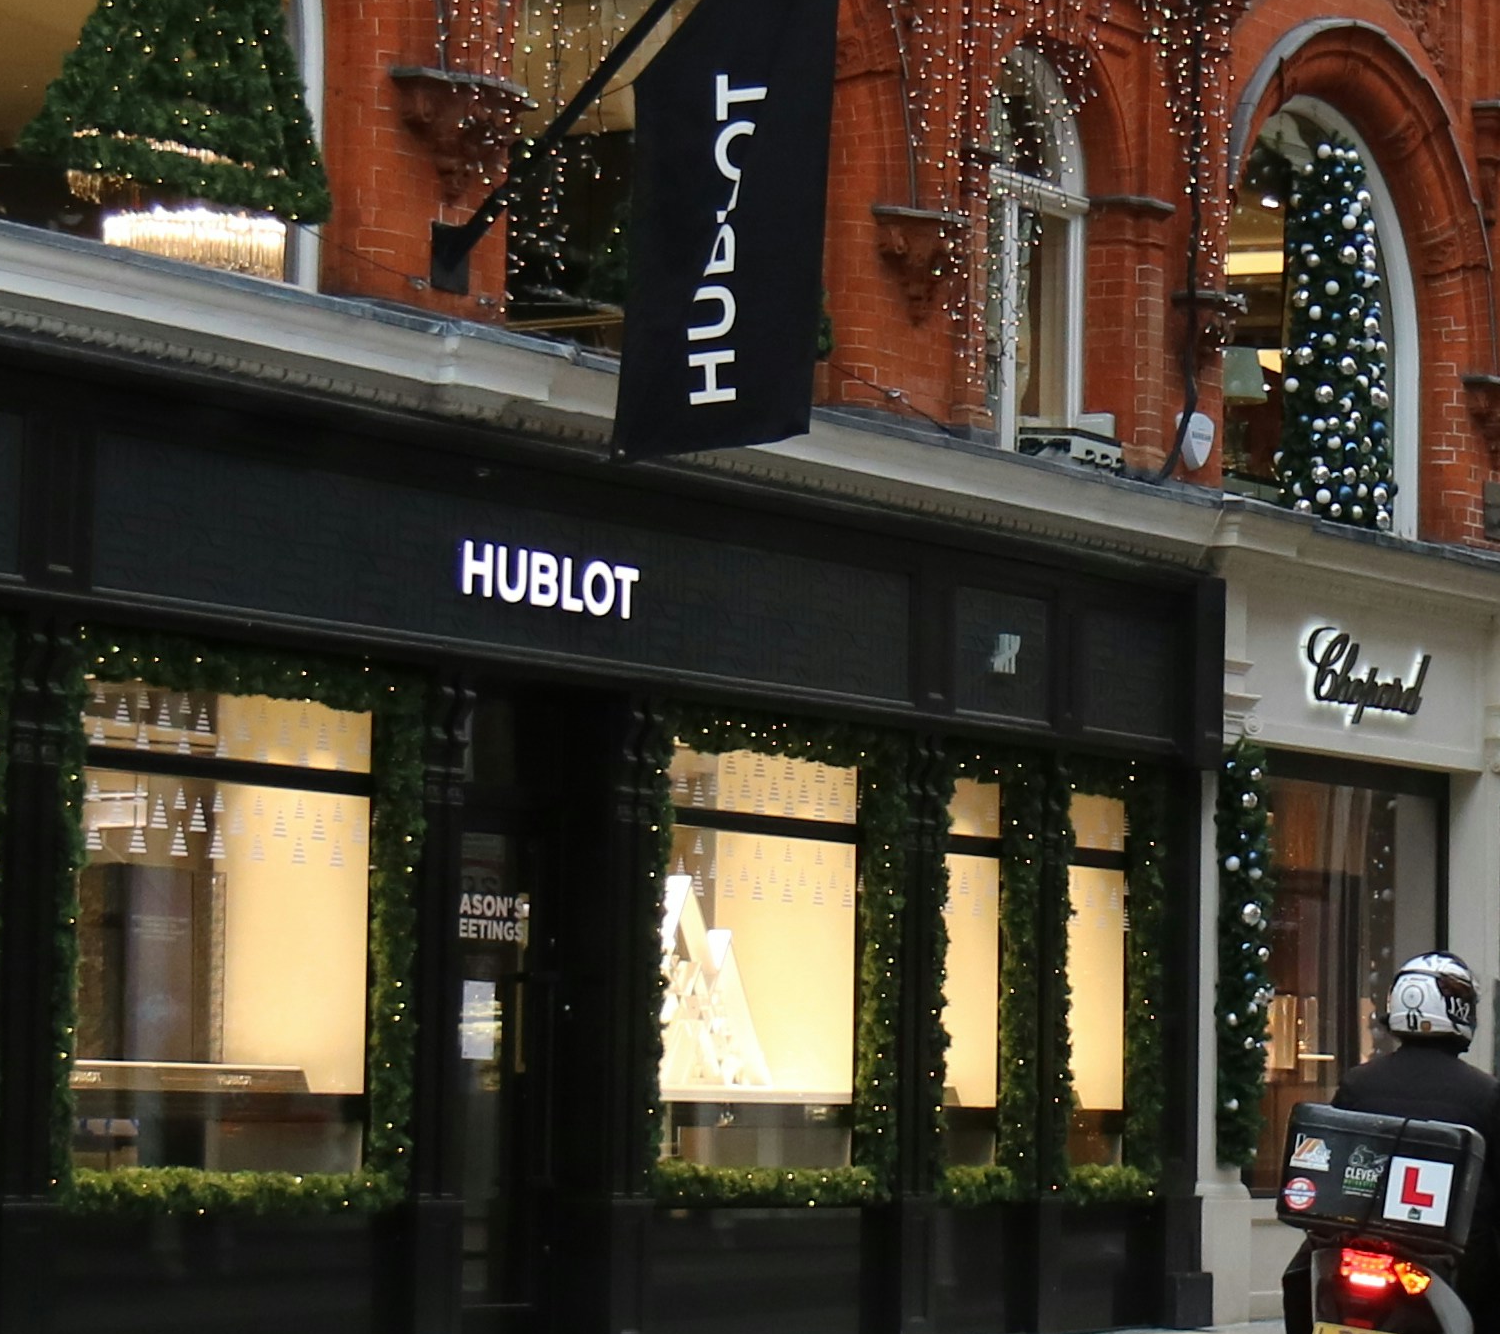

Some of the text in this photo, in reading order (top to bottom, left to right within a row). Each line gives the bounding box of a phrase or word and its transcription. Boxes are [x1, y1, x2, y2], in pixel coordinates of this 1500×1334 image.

[462, 539, 641, 620] HUBLOT
[1307, 626, 1432, 725] Chopard
[460, 918, 524, 941] EETINGS
[1345, 1166, 1378, 1183] CLEVER
[1401, 1166, 1434, 1208] L
